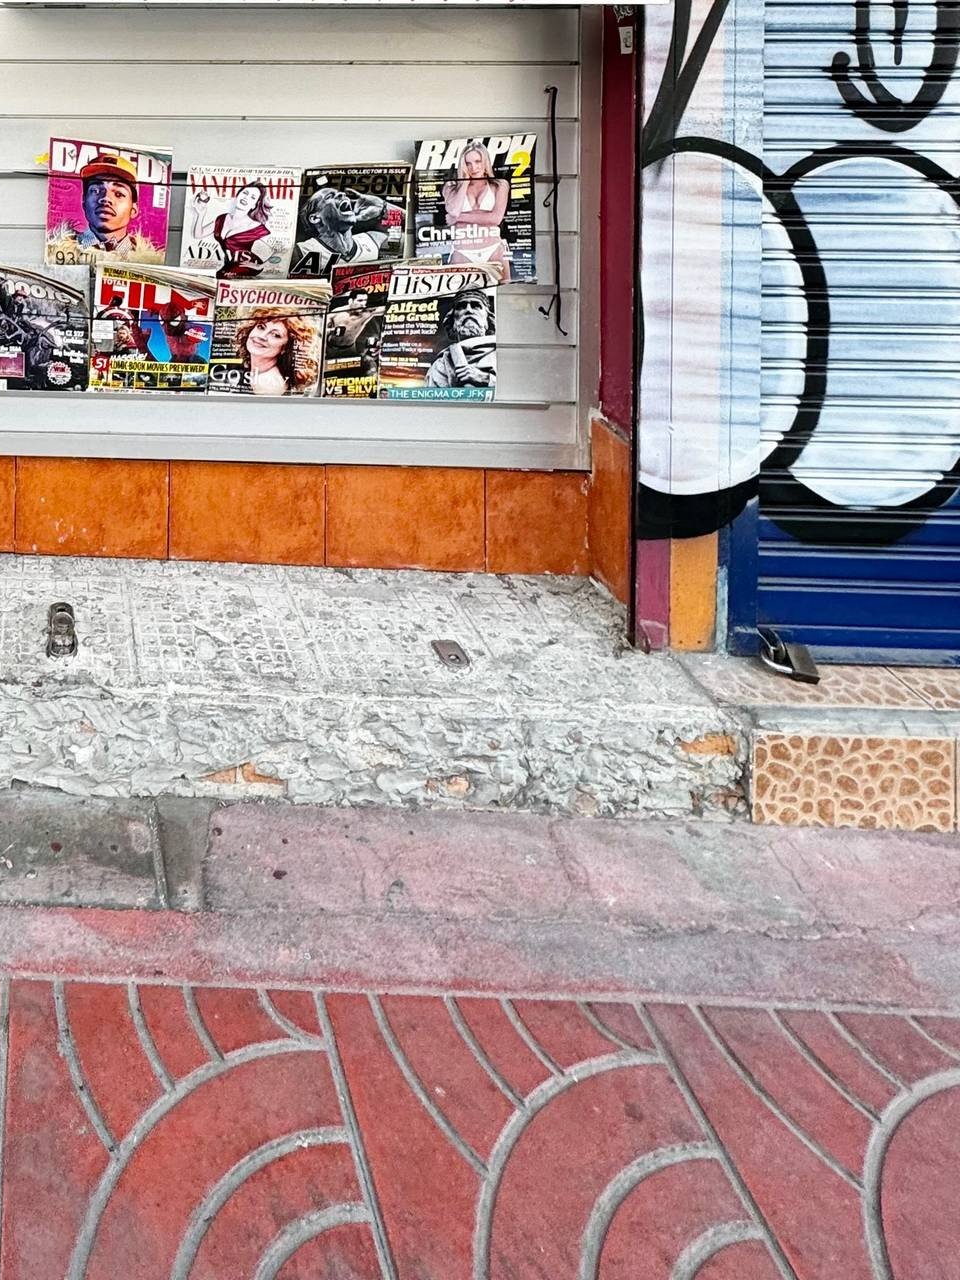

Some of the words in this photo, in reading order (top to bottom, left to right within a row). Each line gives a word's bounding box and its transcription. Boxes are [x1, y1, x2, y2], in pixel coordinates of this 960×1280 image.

[415, 135, 537, 171] RAPH
[266, 176, 296, 201] AIR
[417, 223, 501, 242] Christina
[102, 278, 128, 287] TOTAL
[99, 280, 210, 316] FILM
[387, 300, 438, 314] Alfred
[384, 313, 406, 323] the
[406, 311, 440, 323] Great
[390, 389, 410, 399] THE
[411, 389, 450, 399] ENIGMA
[451, 389, 466, 398] OF
[466, 389, 485, 398] JFK
